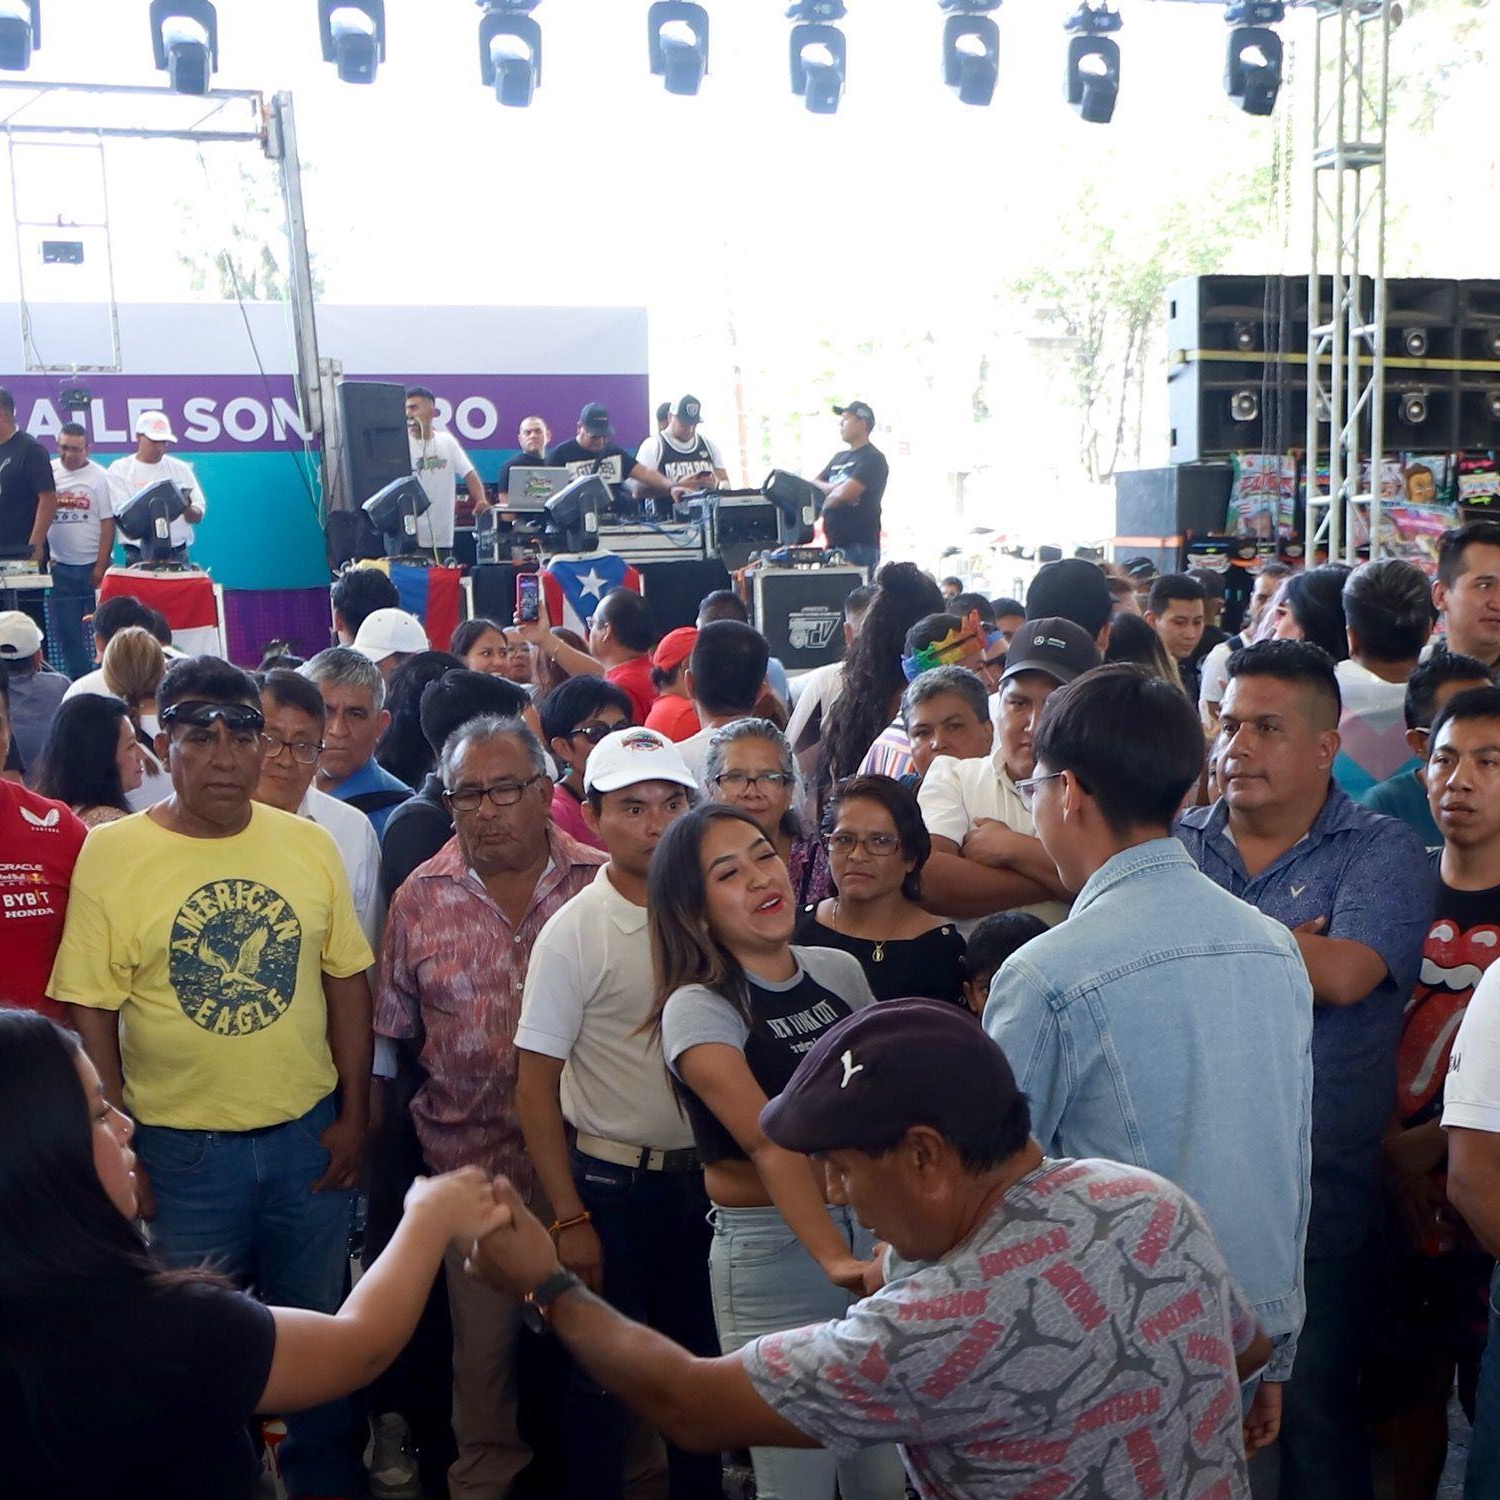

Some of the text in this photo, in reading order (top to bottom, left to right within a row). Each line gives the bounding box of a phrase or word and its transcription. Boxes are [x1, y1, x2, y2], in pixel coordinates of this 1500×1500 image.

[2, 889, 50, 908] BYBIT
[5, 908, 55, 919] HONDA
[172, 880, 301, 956] AMERICAN
[195, 987, 288, 1035] EAGLE
[786, 1009, 823, 1035] YORK
[812, 998, 839, 1025] CITY
